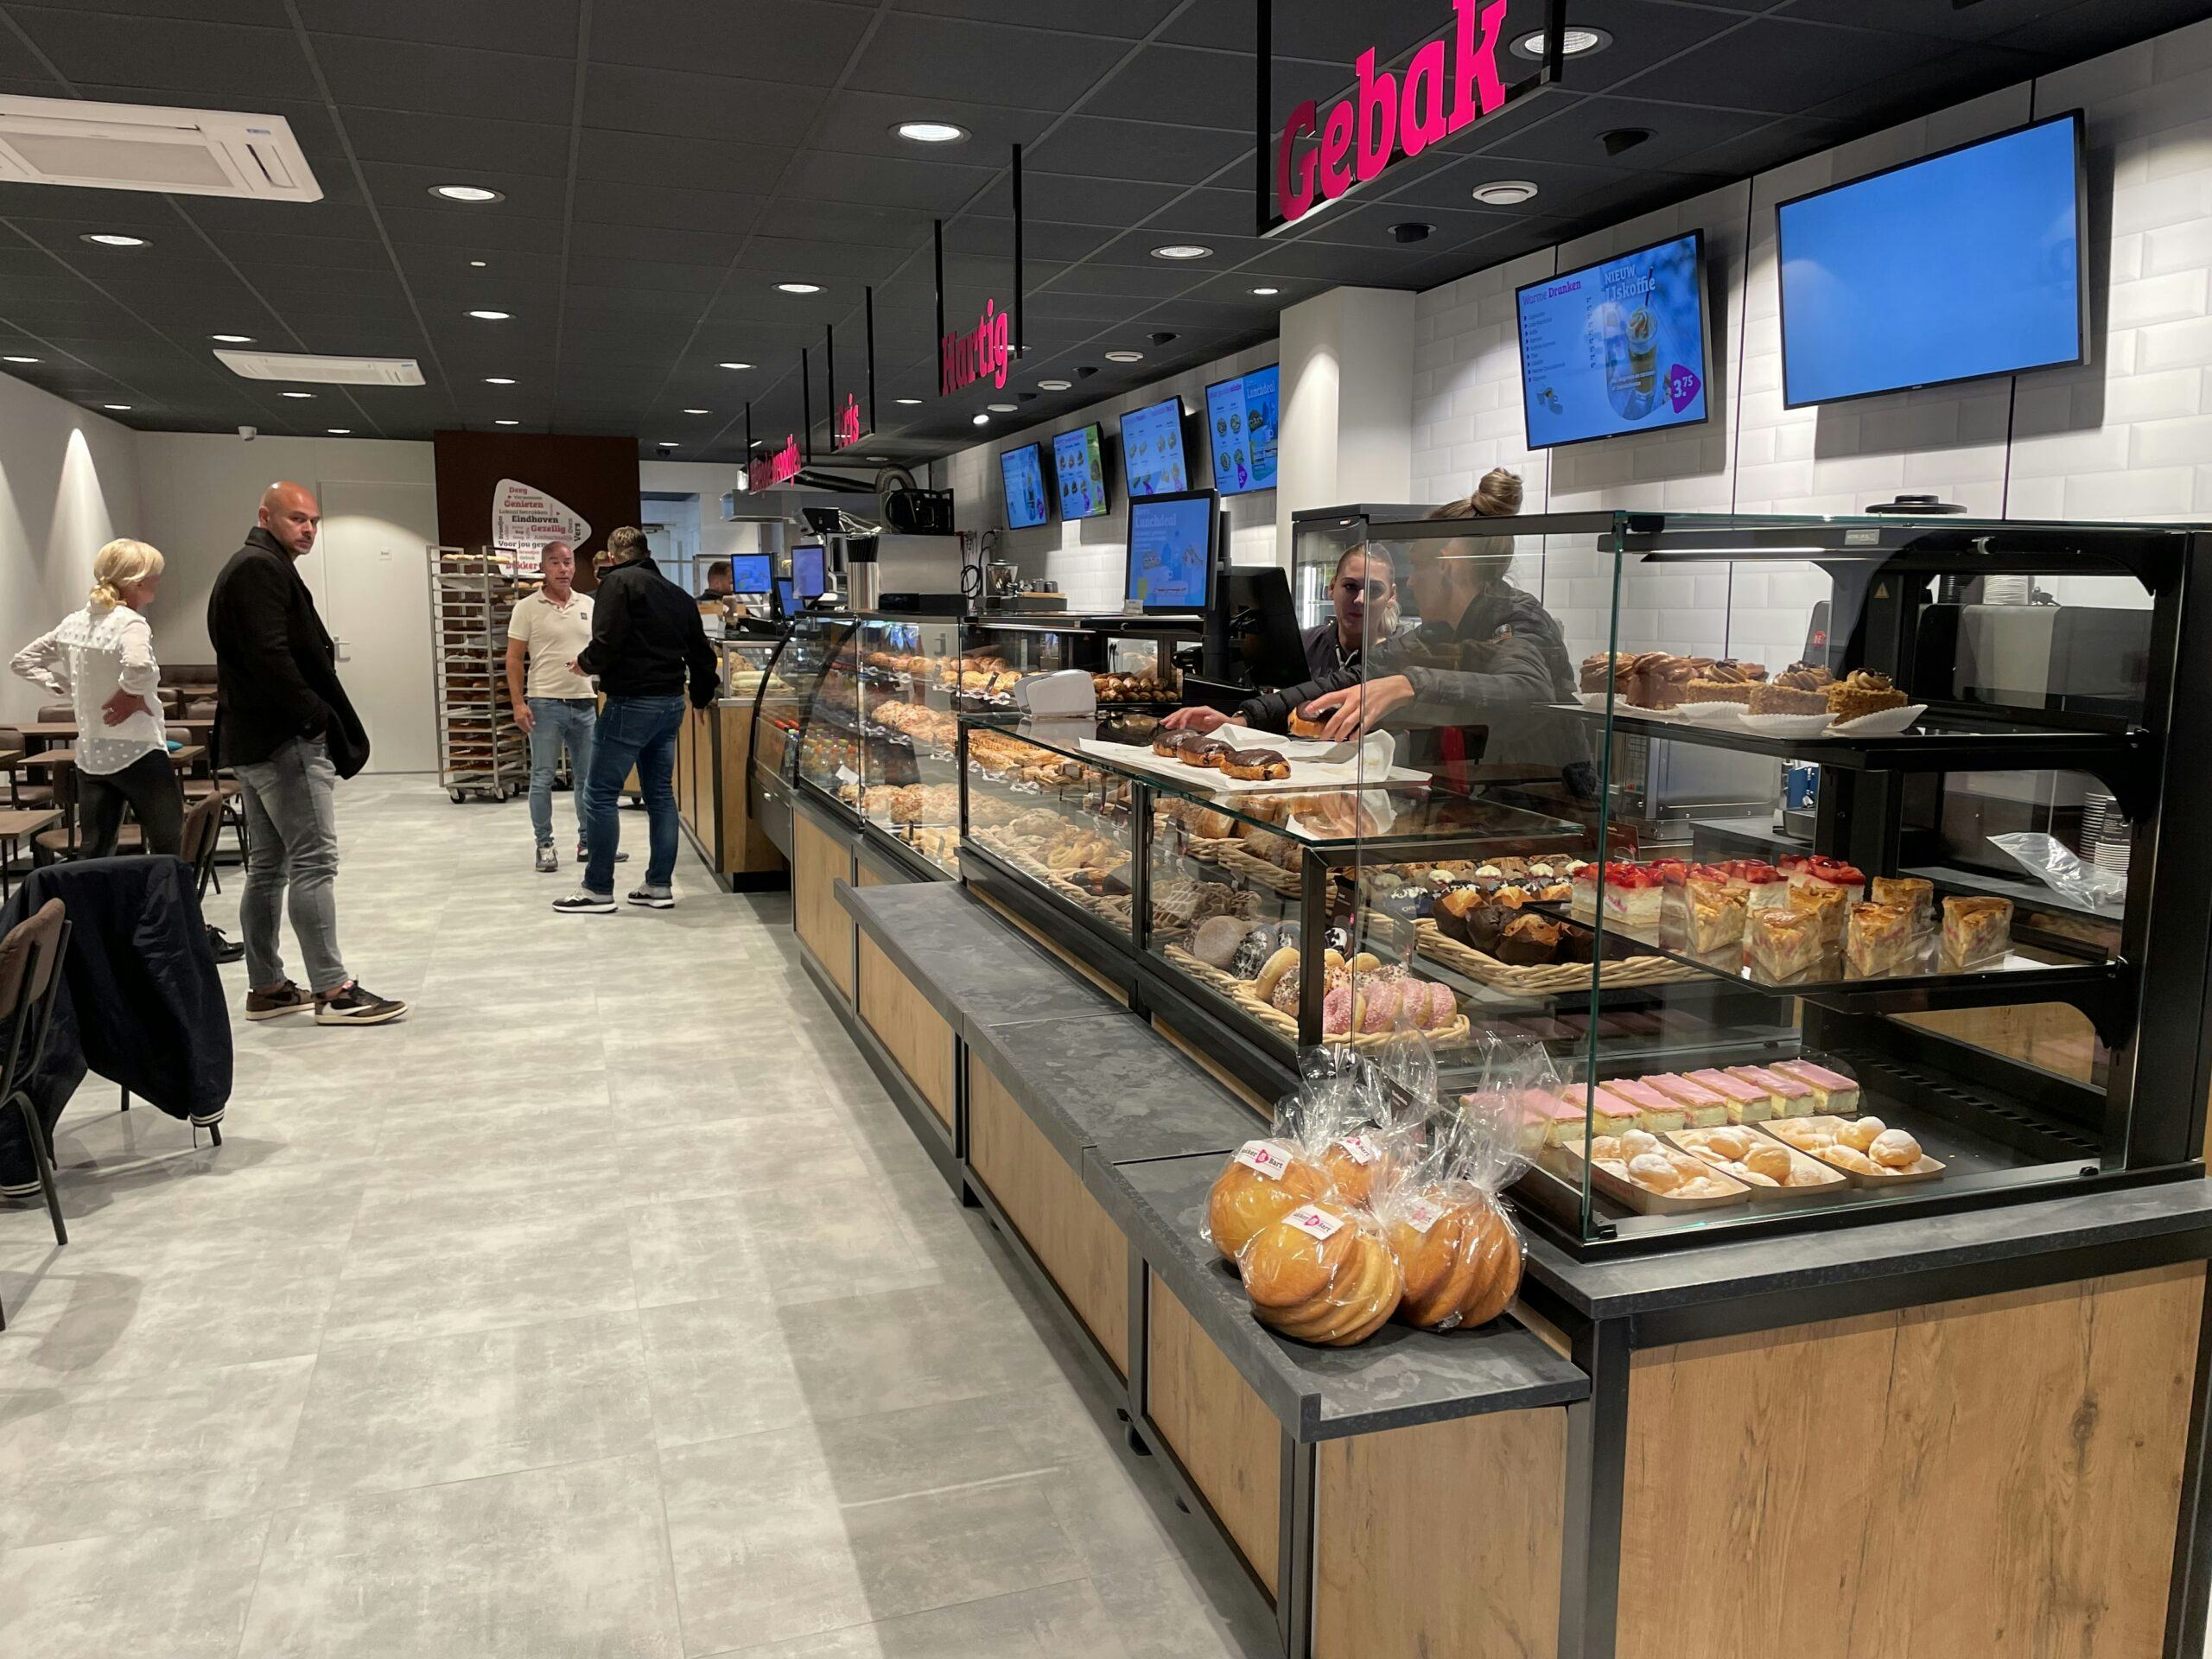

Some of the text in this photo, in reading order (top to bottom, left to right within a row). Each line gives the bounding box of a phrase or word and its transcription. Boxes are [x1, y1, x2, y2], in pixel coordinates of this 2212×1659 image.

[1277, 0, 1508, 221] Gebak
[1604, 264, 1637, 284] NIEUW
[1522, 280, 1582, 306] Warme Dranken
[941, 299, 1009, 397] Hartig
[504, 499, 543, 508] Genieten
[1135, 513, 1177, 528] Lunchdeal
[531, 525, 566, 534] Gezellig
[518, 540, 531, 549] jou
[506, 561, 538, 569] Bkker
[1268, 1157, 1284, 1169] Bart
[1318, 1222, 1332, 1233] Bart
